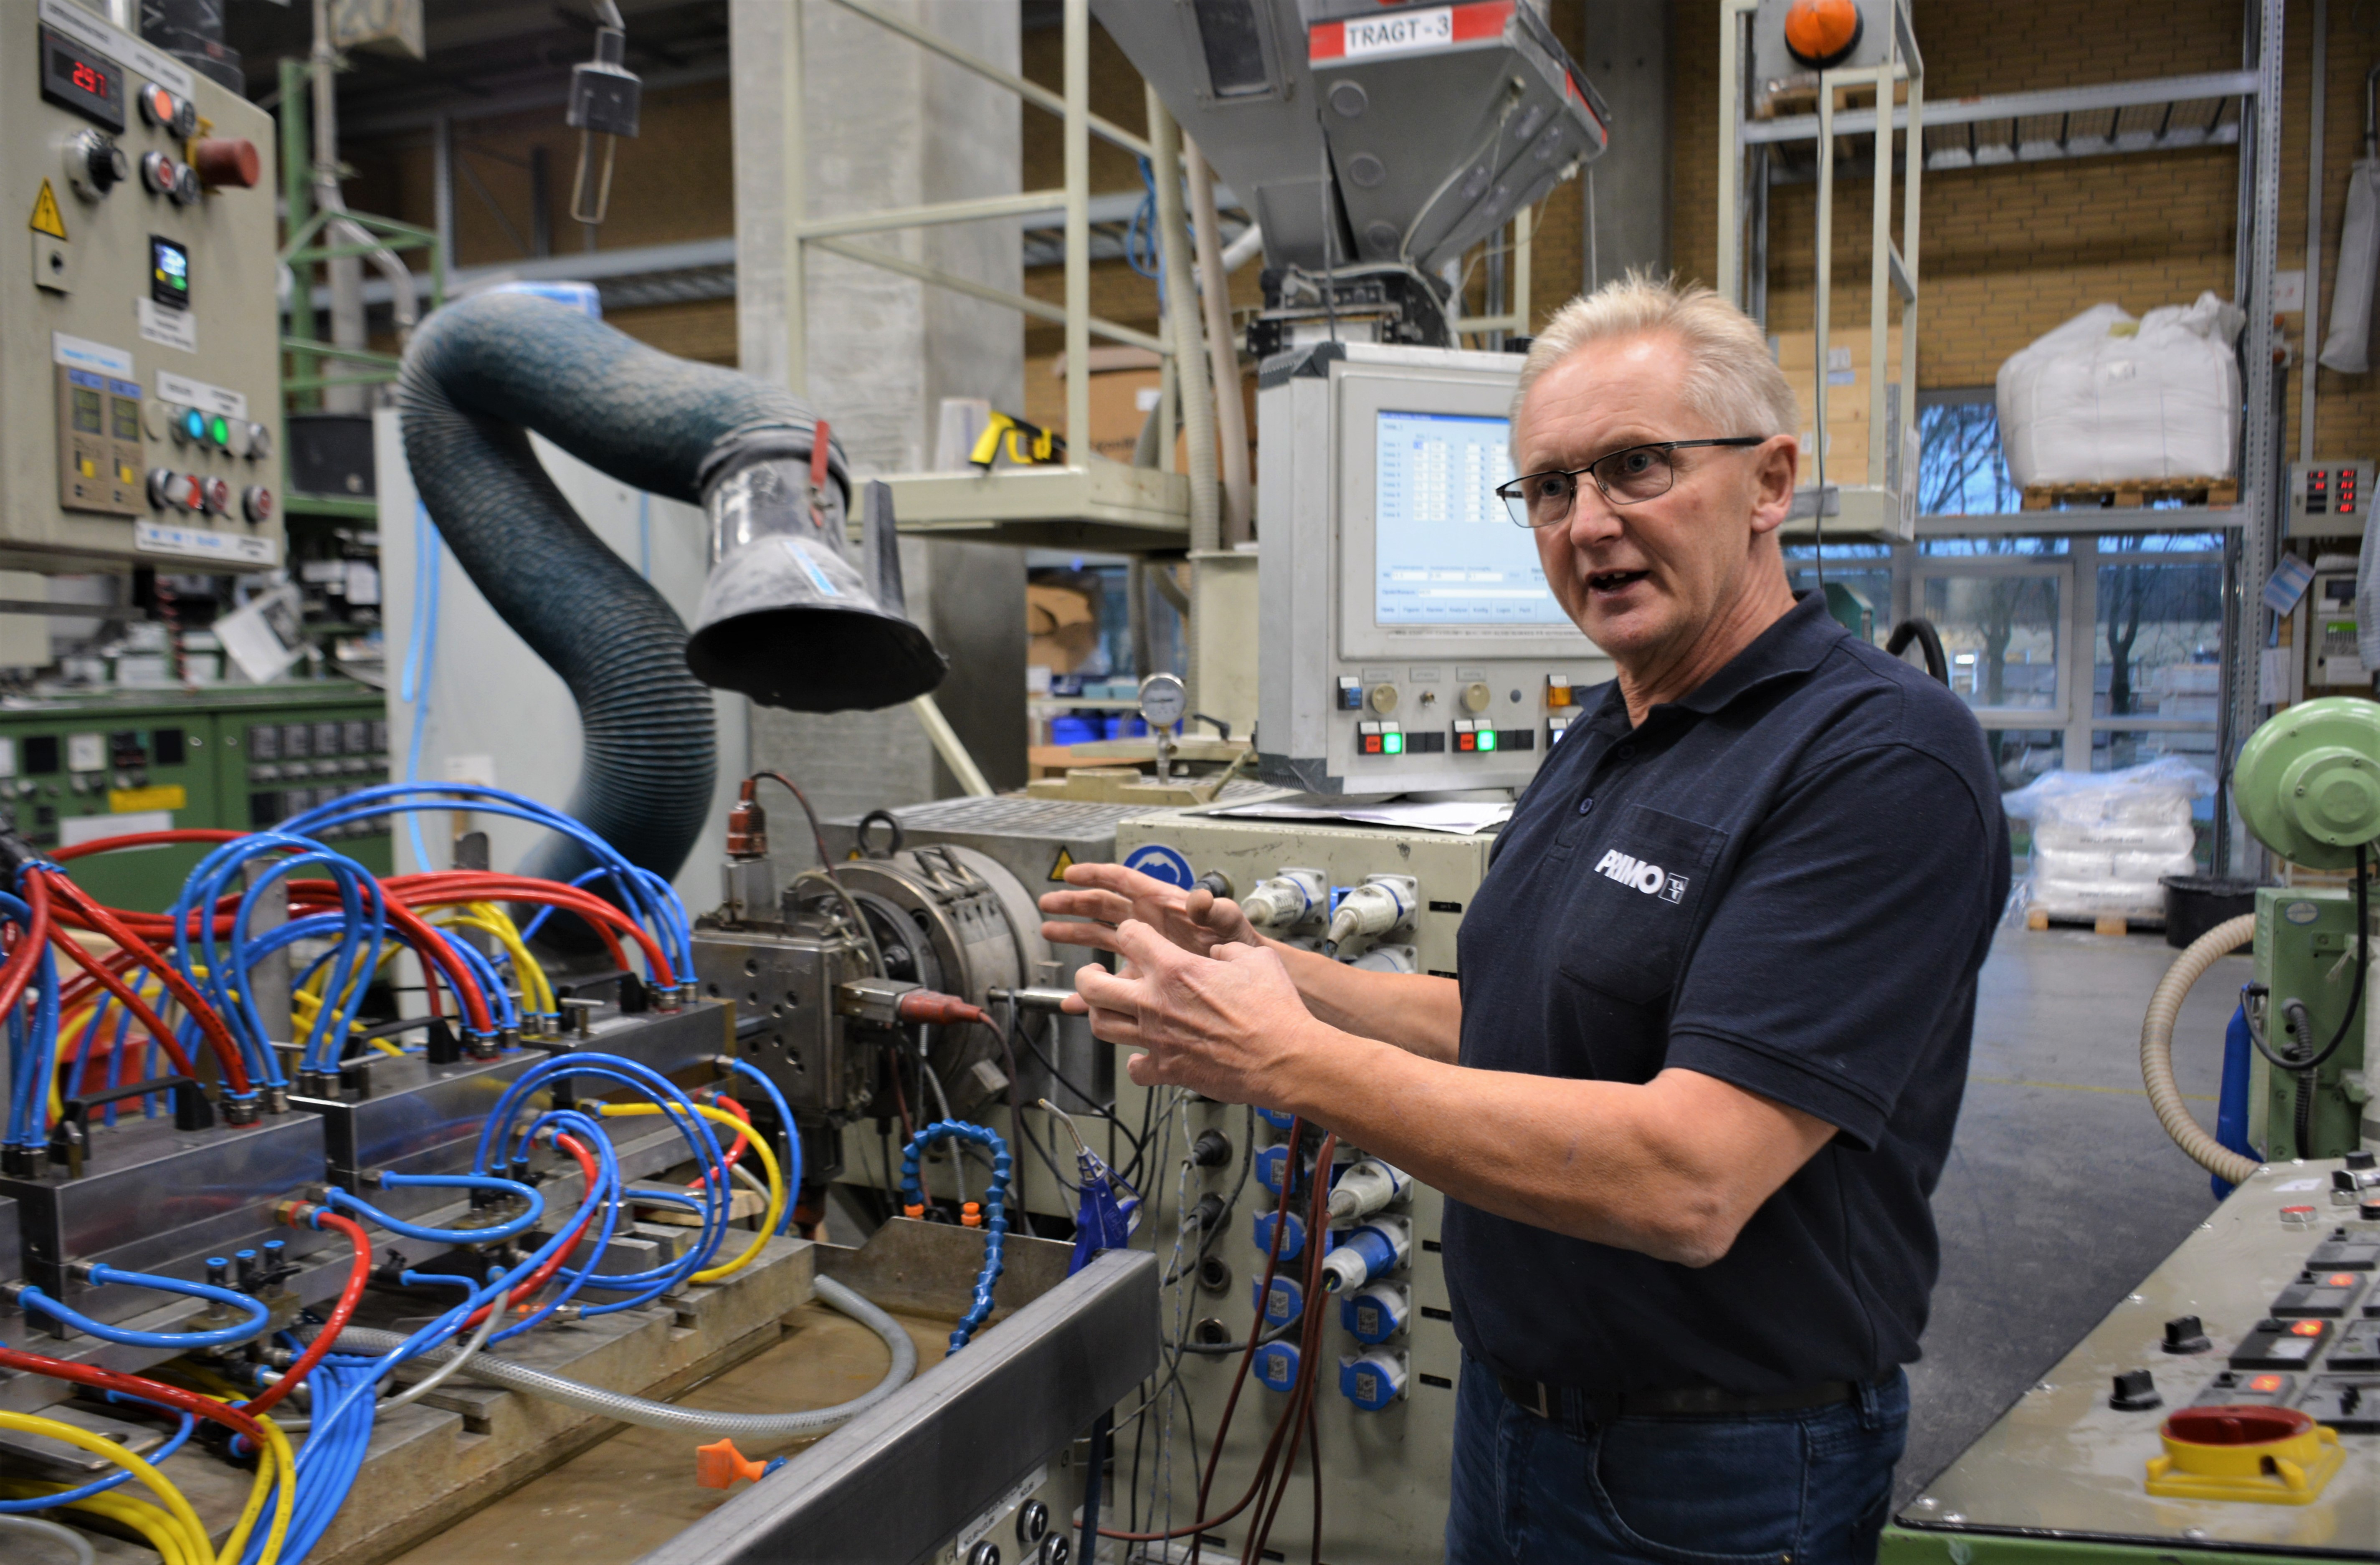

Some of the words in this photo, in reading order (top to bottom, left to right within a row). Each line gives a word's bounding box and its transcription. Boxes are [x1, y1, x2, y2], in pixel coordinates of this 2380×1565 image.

[1348, 18, 1419, 48] TRAGT
[1436, 15, 1449, 36] 3
[1594, 849, 1665, 895] PRIMO
